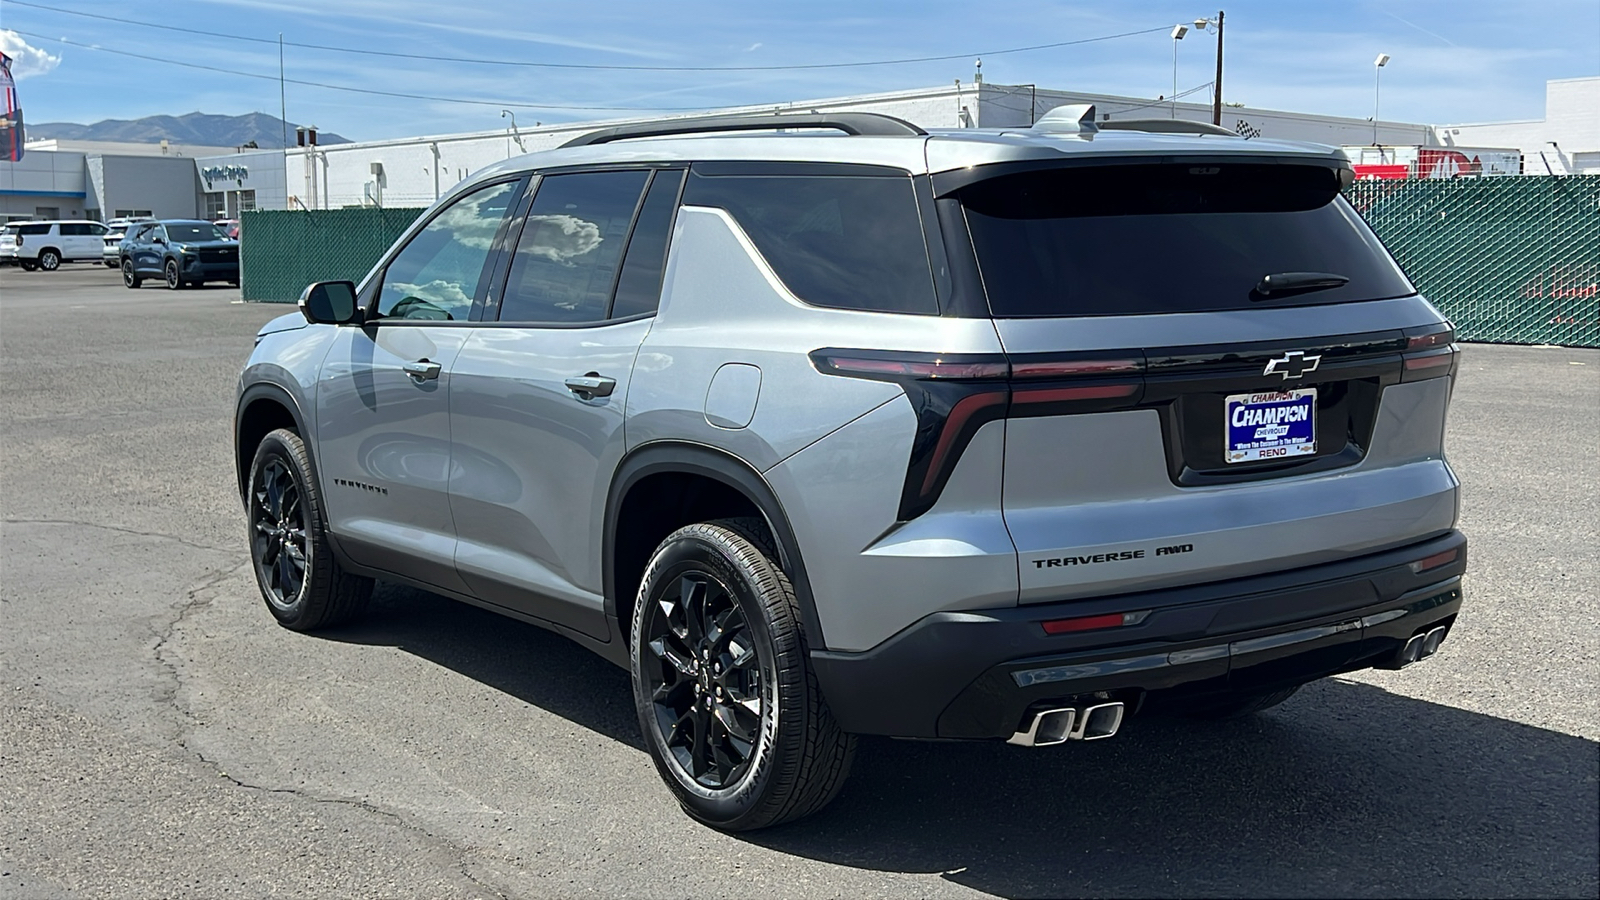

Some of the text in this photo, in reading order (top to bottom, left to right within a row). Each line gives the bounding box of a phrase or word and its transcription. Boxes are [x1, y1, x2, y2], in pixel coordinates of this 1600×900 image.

[1251, 391, 1294, 404] CHAMPION
[1232, 404, 1309, 427] CHAMPION
[1256, 427, 1287, 436] CHEVROLET
[1259, 447, 1287, 458] RENO
[1032, 543, 1194, 569] TRAVERSE AWD
